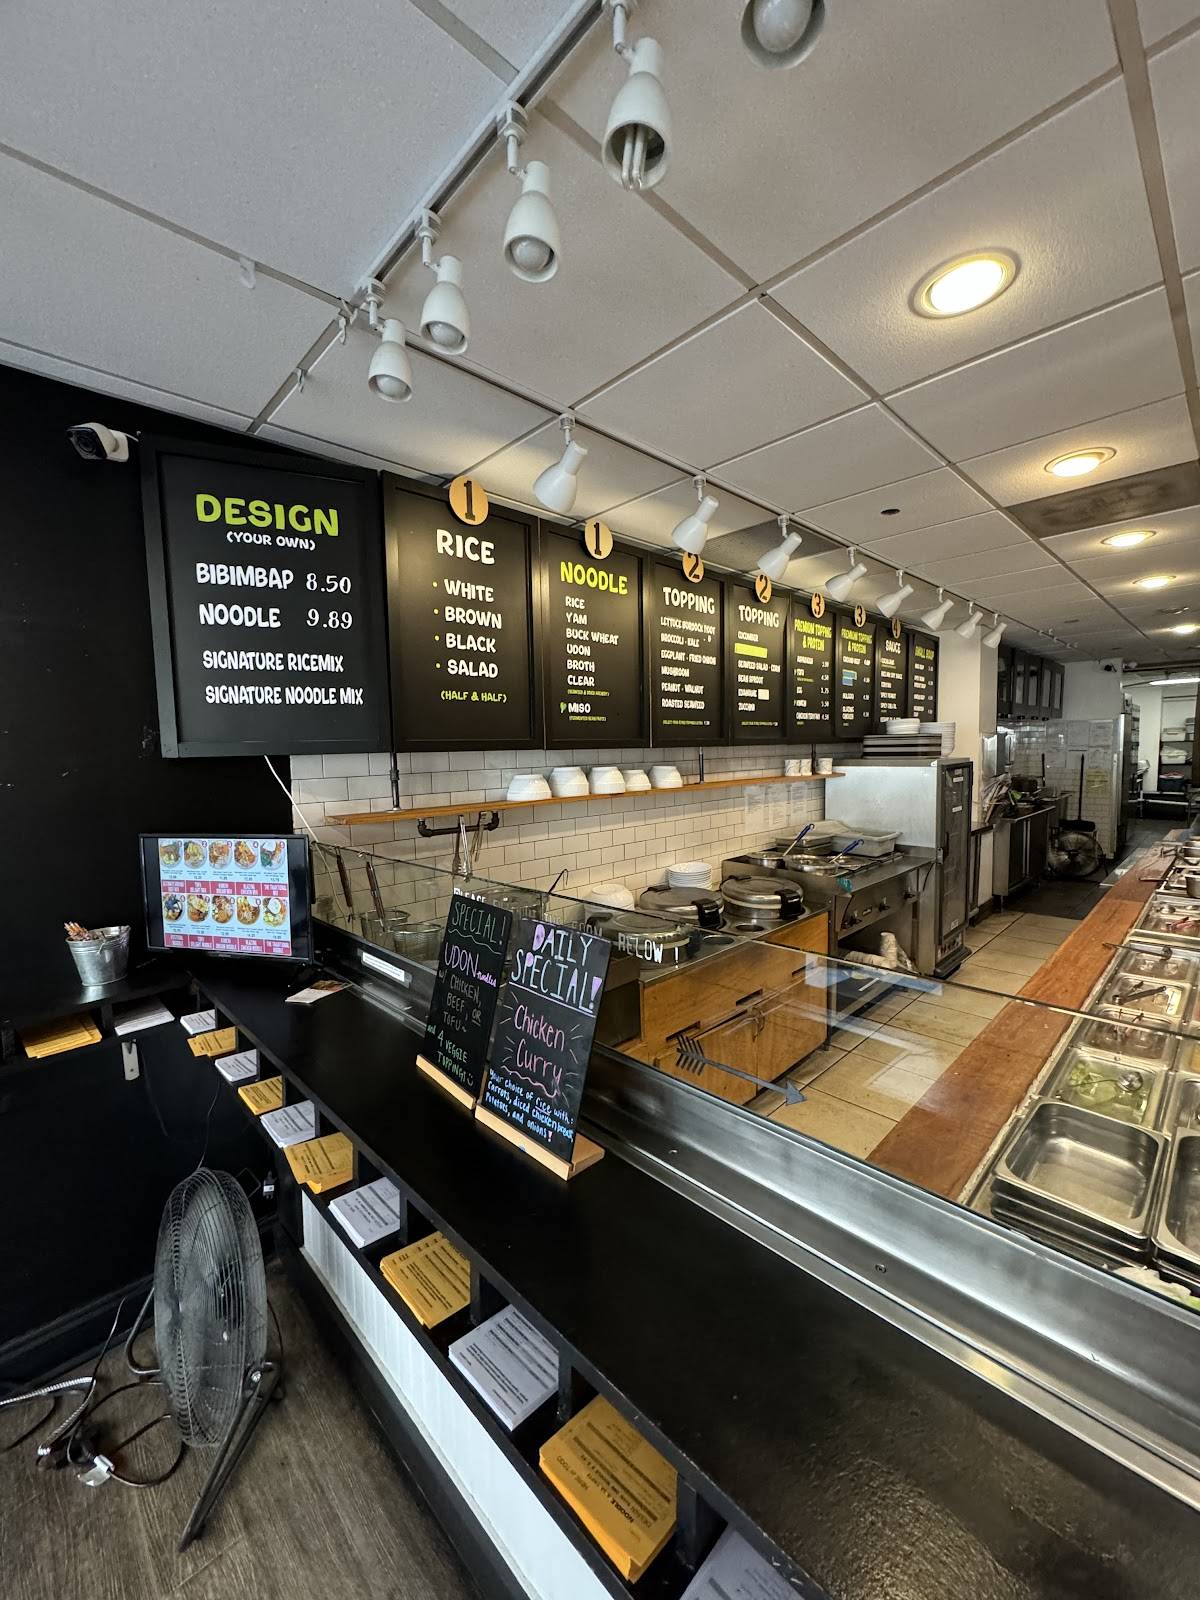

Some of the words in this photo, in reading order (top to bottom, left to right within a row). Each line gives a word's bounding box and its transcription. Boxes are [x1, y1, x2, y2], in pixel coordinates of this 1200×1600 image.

[464, 480, 475, 521] 1
[195, 493, 339, 536] DESIGN
[226, 531, 272, 546] (YOUR
[276, 536, 316, 551] OWN)
[436, 529, 495, 565] RICE
[594, 522, 601, 555] 1
[687, 552, 700, 579] 2
[195, 562, 294, 589] BIBIMBAP
[306, 573, 352, 594] 8.50
[560, 561, 628, 595] NOODLE
[760, 575, 768, 600] 2
[444, 579, 494, 602] WHITE
[662, 587, 715, 614] TOPPING
[565, 596, 585, 609] RICE
[814, 593, 821, 615] 3
[199, 603, 281, 628] NOODLE
[306, 608, 353, 629] 9.89
[445, 606, 502, 629] BROWN
[565, 612, 588, 625] YAM
[660, 616, 682, 629] LETTUCE
[738, 605, 779, 628] TOPPING
[857, 605, 862, 625] 3
[565, 628, 589, 640] BUCK
[591, 631, 619, 645] WHEAT
[794, 618, 815, 635] PREMIUM
[815, 623, 832, 639] TOPPING
[445, 633, 497, 653] BLACK
[566, 643, 591, 656] UDON
[660, 633, 684, 645] BROCCOLI
[687, 637, 700, 648] KALE
[807, 637, 825, 651] PROTEIN
[885, 640, 901, 654] SAUCE
[202, 650, 285, 671] SIGNATURE
[287, 653, 344, 672] RICEMIX
[660, 649, 685, 661] EGGPLANT
[447, 659, 498, 678] SALAD
[566, 659, 595, 672] BROTH
[661, 665, 690, 677] MUSHROOM
[567, 675, 595, 687] CLEAR
[661, 682, 681, 692] PEANUT
[205, 685, 282, 704] SIGNATURE
[285, 686, 337, 705] NOODLE
[339, 688, 364, 705] MIX
[440, 690, 469, 701] (HALF
[471, 691, 479, 701] &
[481, 692, 507, 703] HALF)
[661, 698, 684, 708] ROASTED
[683, 699, 705, 710] SEAWEED
[567, 702, 591, 714] MISO
[532, 924, 593, 966] DAILY
[618, 931, 663, 964] BELOW
[444, 942, 480, 978] UDON
[511, 949, 603, 1014] SPECIAL!
[471, 1008, 482, 1022] OR
[514, 1005, 565, 1053] Chicken
[437, 1030, 444, 1047] 4
[445, 1040, 468, 1064] VEGGIE
[516, 1038, 563, 1086] Curry
[504, 1079, 524, 1097] choice
[525, 1091, 534, 1100] of
[536, 1097, 552, 1114] rice
[512, 1096, 530, 1113] diced
[512, 1110, 524, 1125] and
